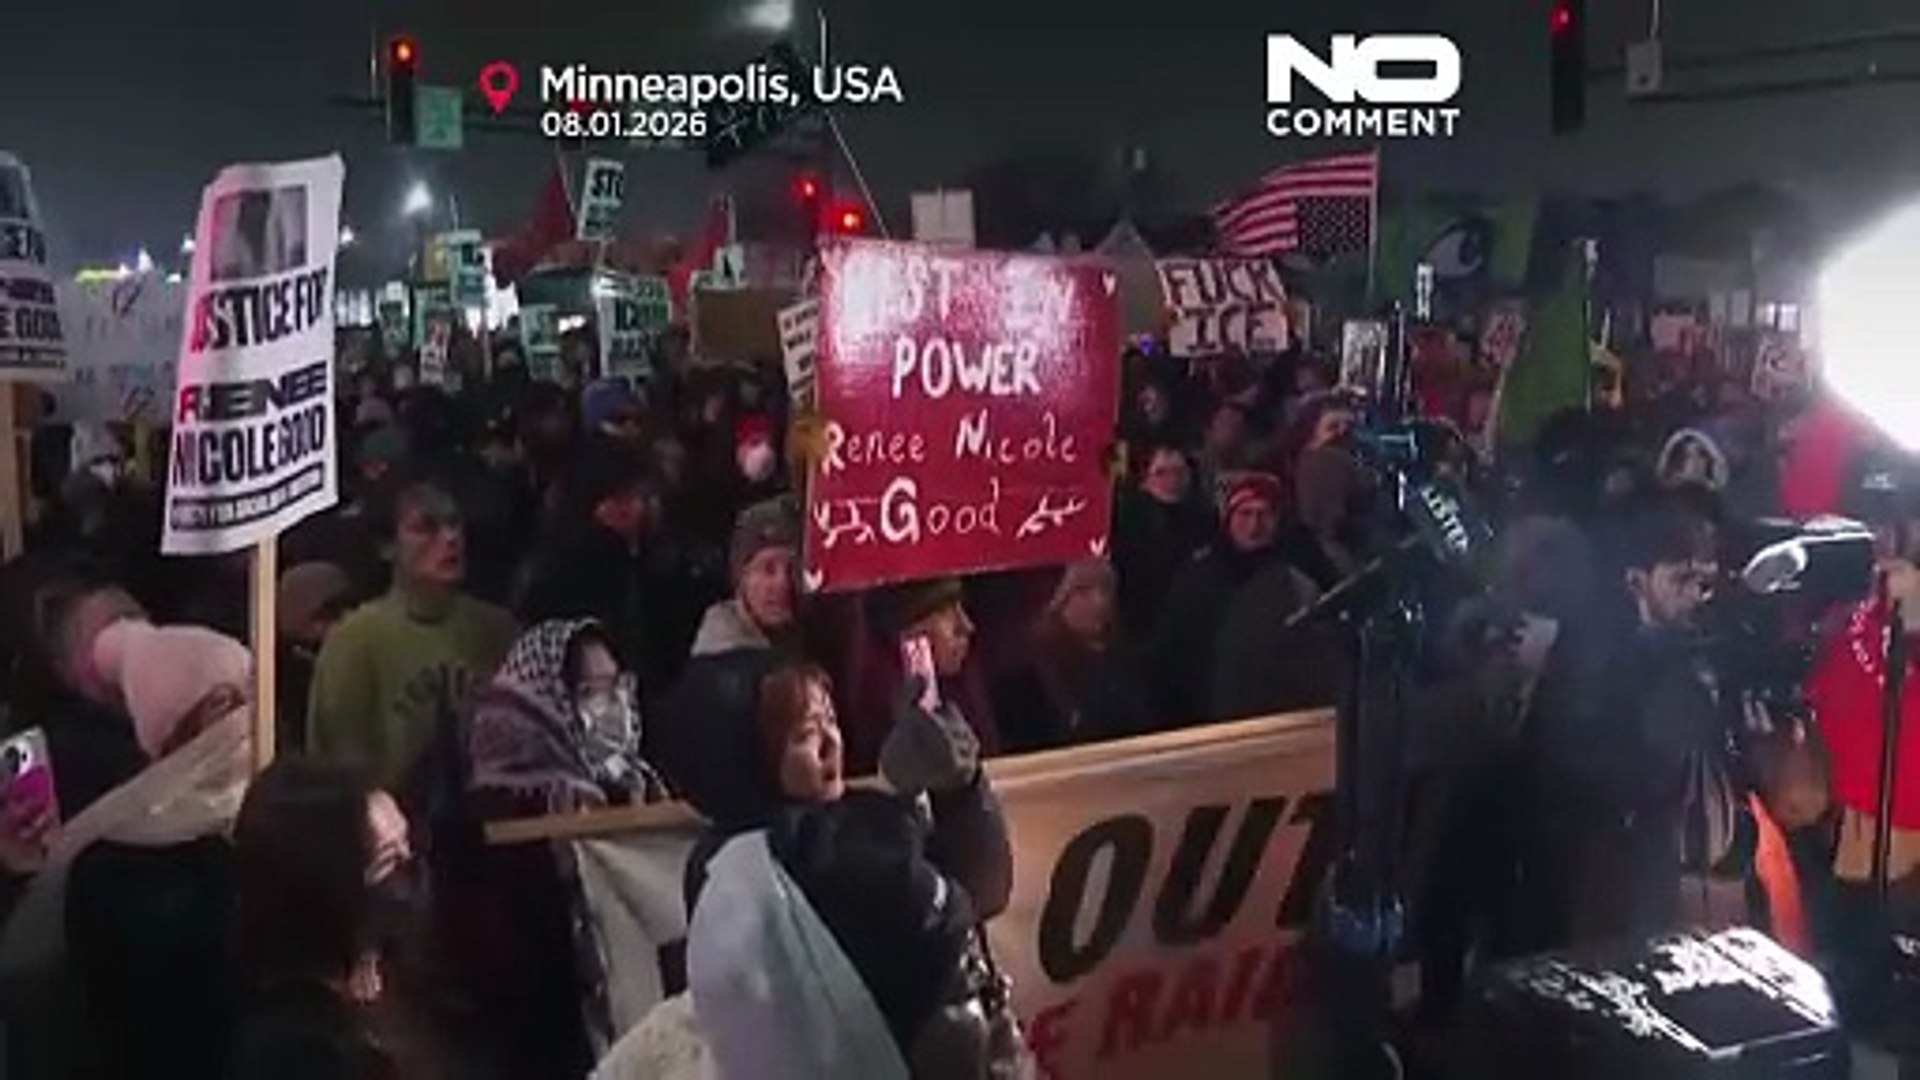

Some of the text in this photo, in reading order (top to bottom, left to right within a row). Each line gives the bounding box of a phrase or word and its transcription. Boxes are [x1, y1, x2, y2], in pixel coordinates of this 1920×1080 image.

[836, 249, 963, 323] ST
[1164, 260, 1287, 305] FUCK
[1183, 302, 1277, 352] ICE
[179, 360, 327, 423] RENEE
[892, 337, 1042, 399] POWER
[172, 423, 276, 487] NICOLE
[822, 409, 1079, 475] Renee Nicole
[880, 476, 1001, 544] Good
[1037, 792, 1340, 984] OUT
